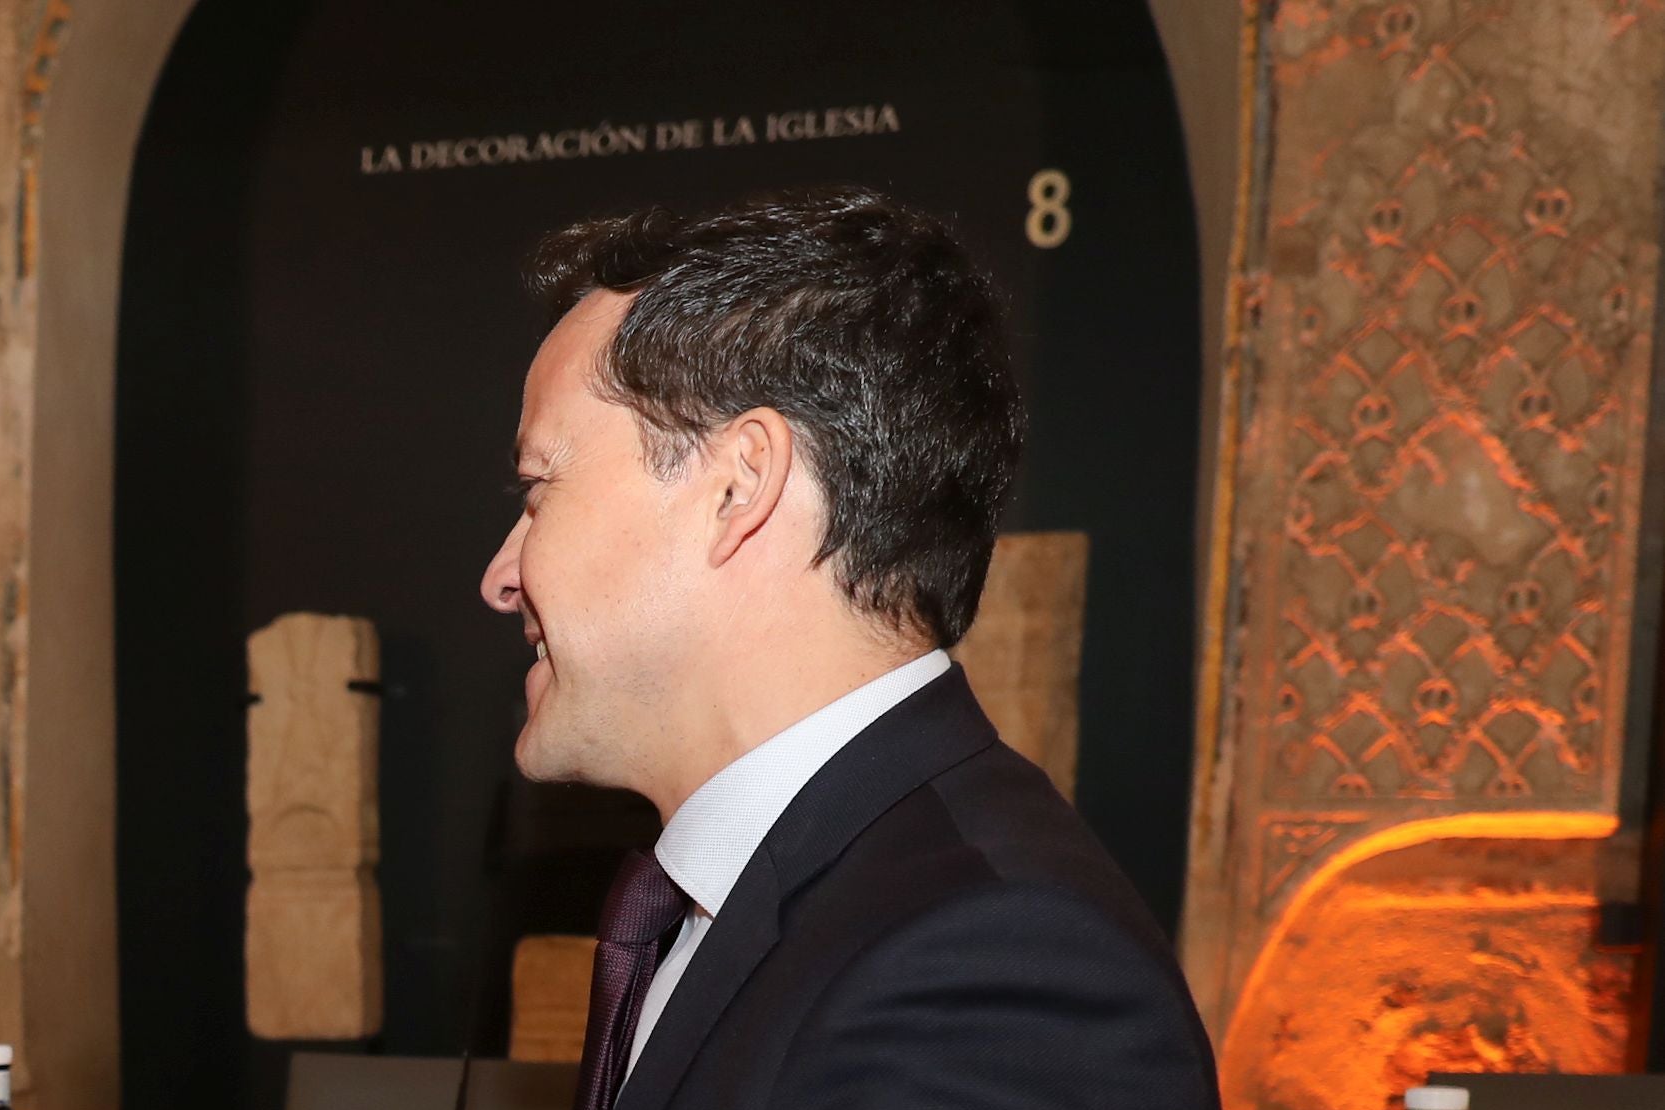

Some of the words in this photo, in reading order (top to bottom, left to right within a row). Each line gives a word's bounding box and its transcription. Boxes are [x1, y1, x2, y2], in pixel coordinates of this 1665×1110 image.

[361, 144, 402, 174] LA
[410, 120, 647, 170] DECORACIÓN
[656, 119, 703, 150] DE
[712, 115, 756, 146] LA
[766, 102, 900, 143] IGLESIA
[1025, 168, 1072, 249] 8
